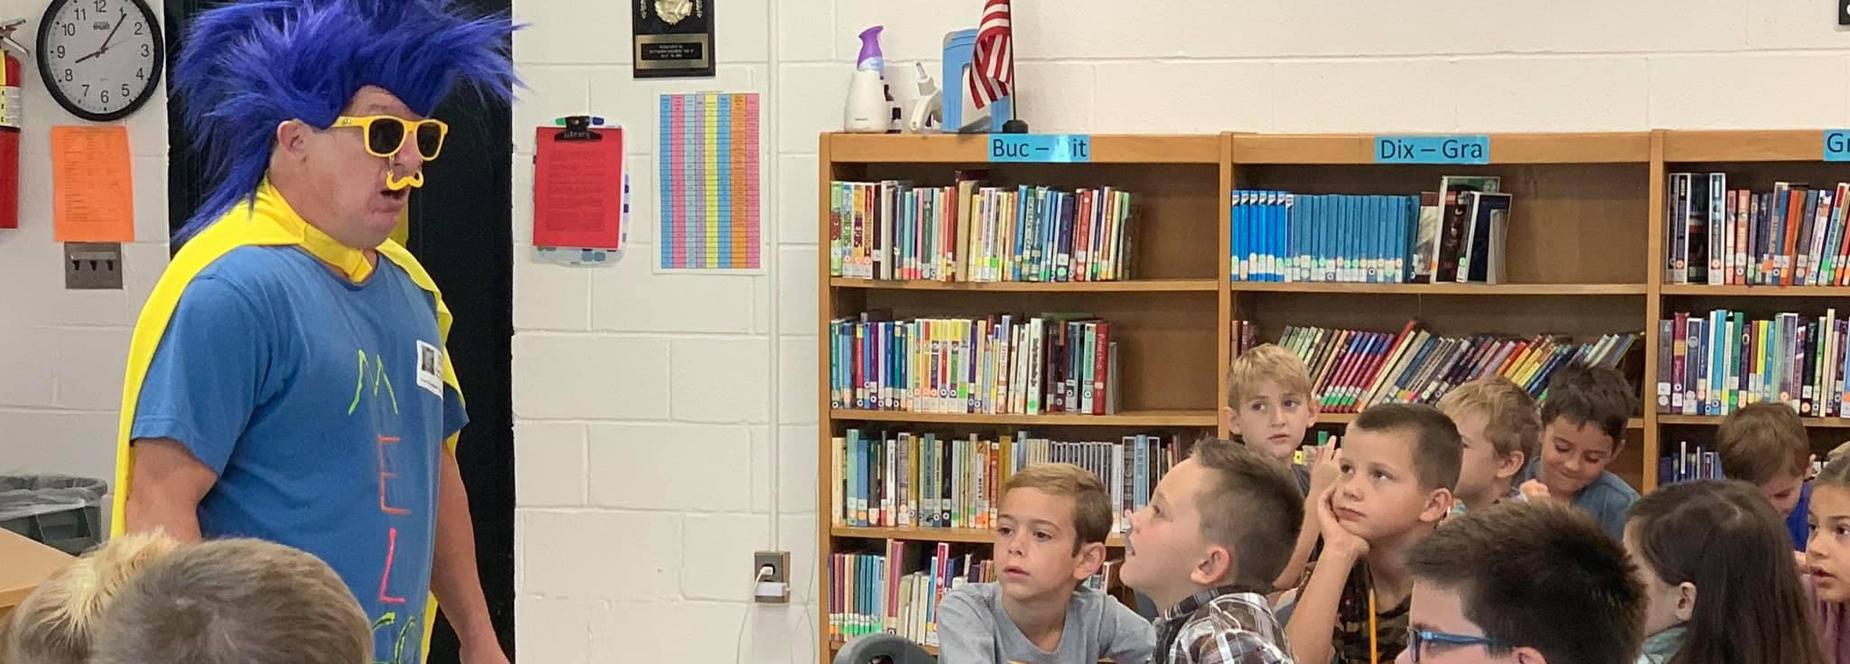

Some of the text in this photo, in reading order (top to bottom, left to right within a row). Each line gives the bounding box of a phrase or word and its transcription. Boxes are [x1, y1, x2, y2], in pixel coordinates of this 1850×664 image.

[94, 0, 107, 13] 12
[74, 9, 87, 21] 11
[62, 23, 76, 37] 10
[134, 22, 143, 36] 2
[57, 45, 66, 59] 9
[141, 44, 150, 58] 3
[65, 68, 73, 82] 8
[135, 67, 144, 81] 4
[82, 84, 90, 97] 7
[100, 90, 109, 104] 6
[121, 84, 130, 97] 5
[993, 138, 1030, 157] Buc
[1381, 139, 1414, 159] Dix
[1442, 139, 1482, 159] Gra
